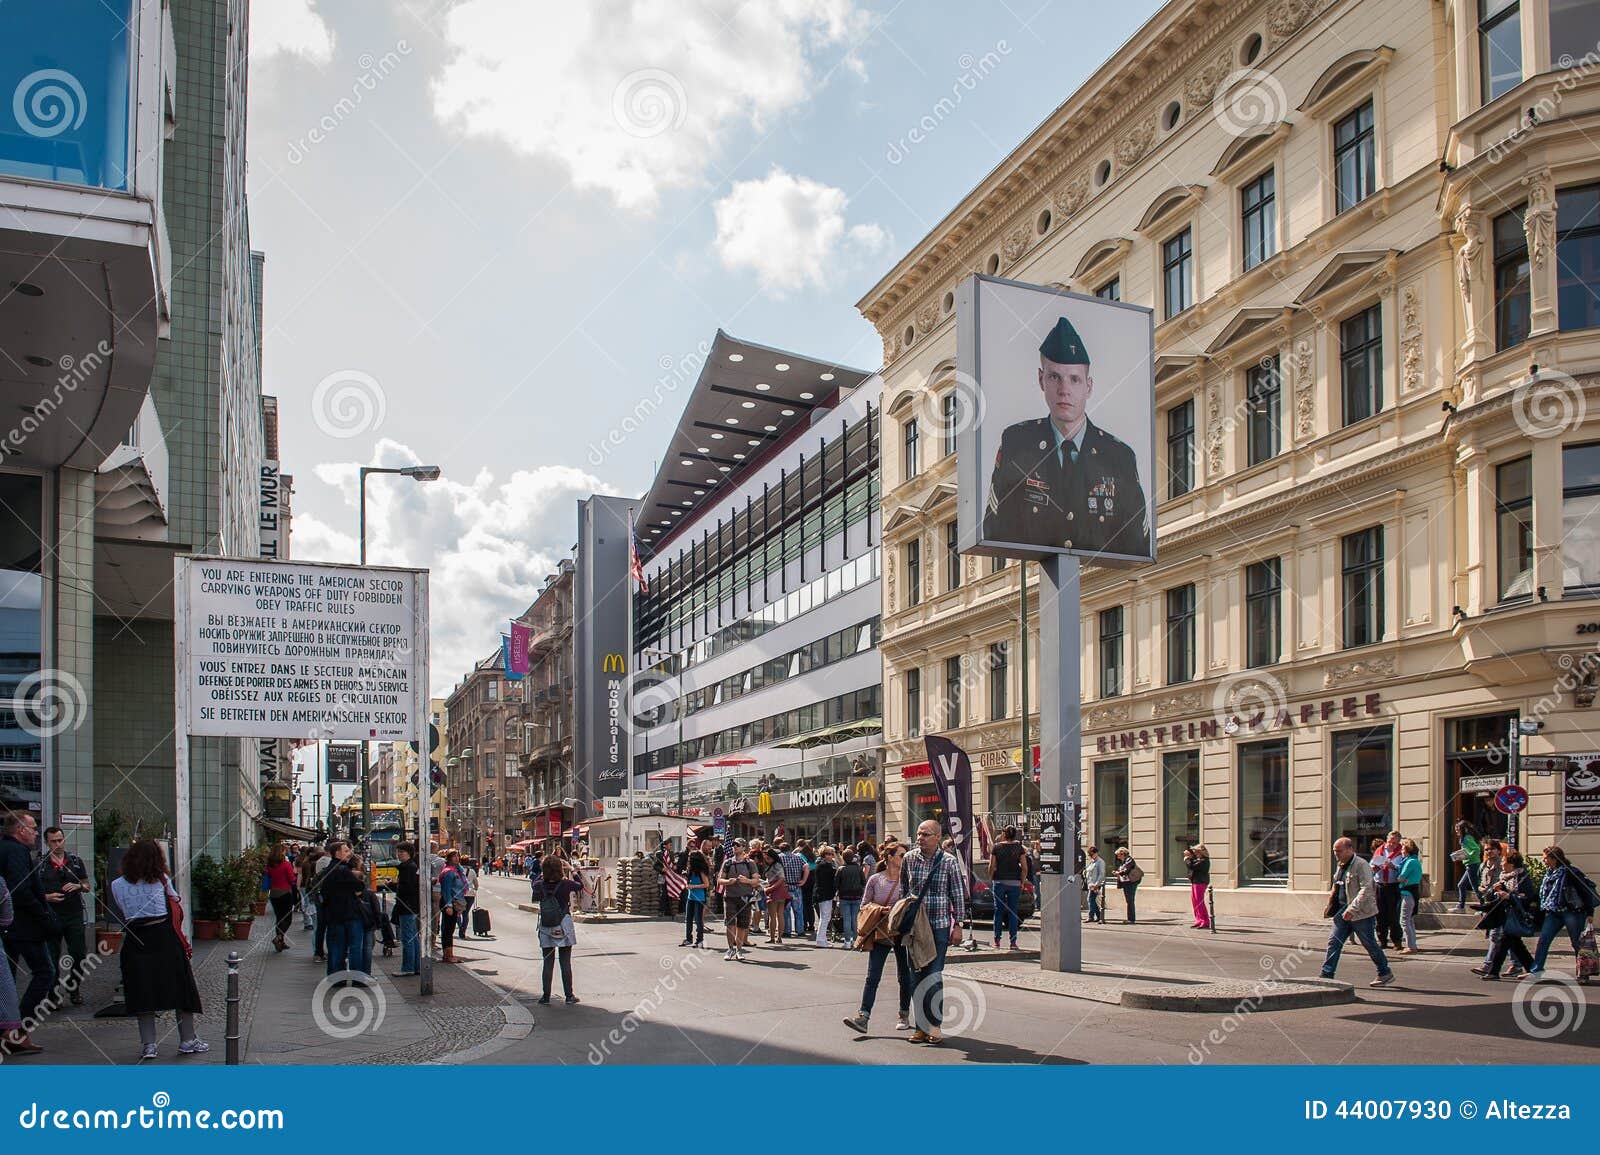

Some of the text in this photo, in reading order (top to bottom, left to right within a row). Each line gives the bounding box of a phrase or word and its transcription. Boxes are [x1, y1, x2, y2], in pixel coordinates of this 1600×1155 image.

[260, 466, 278, 508] MUR
[260, 513, 277, 530] LE
[202, 568, 403, 591] YOU ARE ENTERING THE AMERICAN SECTOR
[201, 583, 402, 604] CARRYING WEAPONS OFF DUTY FORBIDDEN
[256, 599, 355, 614] OBEY TRAFFIC RULES
[209, 615, 223, 625] ВЫ
[282, 618, 287, 629] В
[293, 620, 365, 632] АМЕРИКАНСКИЙ
[370, 624, 400, 635] СЕКТОР
[200, 628, 230, 639] НОСИТЬ
[233, 629, 265, 640] ОРУЖИЕ
[269, 631, 314, 644] ЗАПРЕЩЕНО
[318, 634, 323, 643] В
[326, 634, 380, 647] НЕСЛУЖЕБНОЕ
[285, 646, 339, 658] ДОРОЖНЫМ
[346, 648, 394, 660] ПРАВИЛАМ
[200, 661, 225, 672] VOUS
[232, 663, 265, 674] ENTREZ
[271, 664, 295, 675] DANS
[301, 665, 309, 676] LE
[314, 666, 353, 677] SECTEUR
[199, 676, 408, 692] DEFENSE DE PORTER DES ARMES EN DEHORS DU SERVICE
[211, 688, 397, 704] OBÉISSEZ AUX REGLES DE CIRCULATION
[201, 707, 407, 724] SIE BETRETEN DEN AMERIKANISCHEN SEKTOR
[1097, 693, 1380, 753] EINSTEIN KAFFEE
[980, 750, 1007, 768] GIRLS
[790, 784, 849, 808] McDonald's
